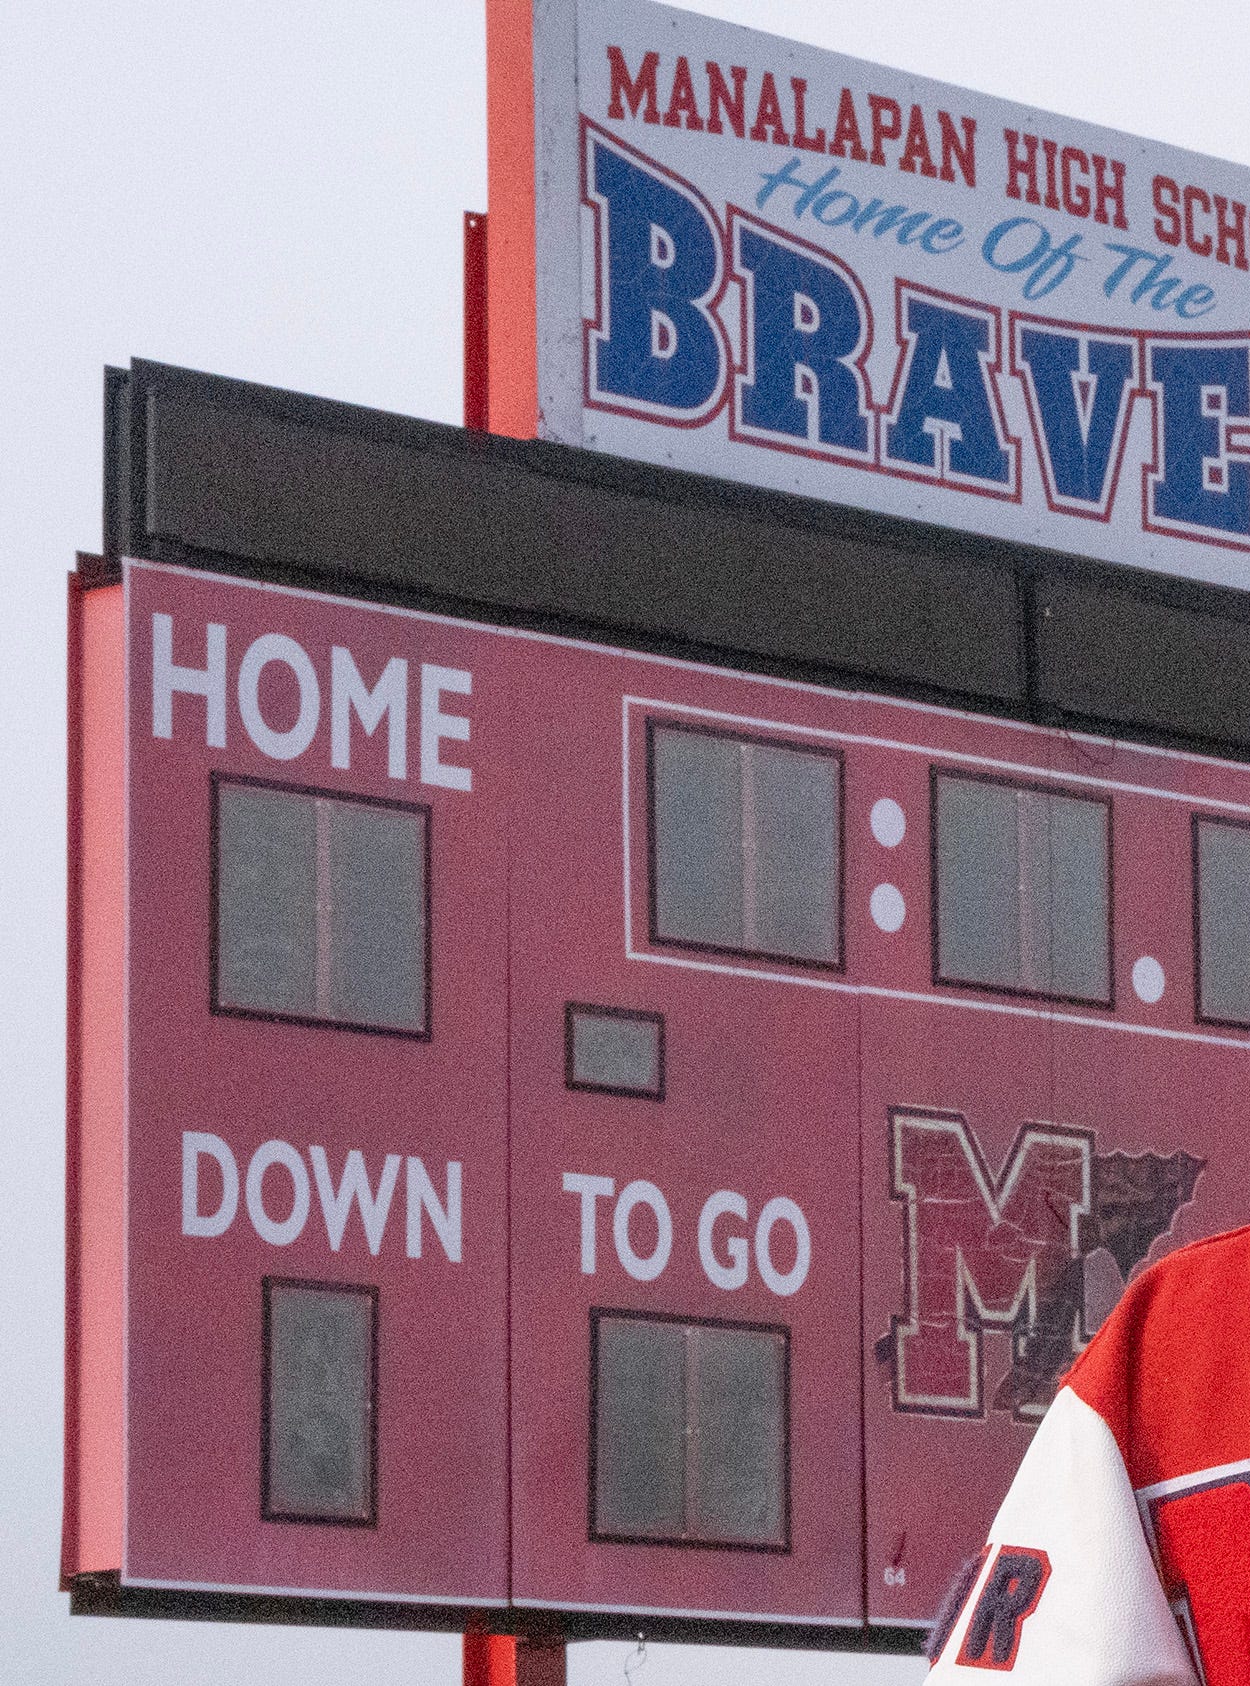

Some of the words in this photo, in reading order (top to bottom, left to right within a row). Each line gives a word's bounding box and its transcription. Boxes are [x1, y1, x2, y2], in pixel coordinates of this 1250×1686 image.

[607, 45, 975, 186] MANALAPAN
[1004, 129, 1128, 229] HIGH
[753, 157, 966, 255] Home
[981, 215, 1088, 301] Of
[1102, 241, 1217, 320] The
[151, 613, 473, 792] HOME
[181, 1131, 463, 1264] DOWN
[562, 1172, 673, 1283] TO
[697, 1190, 812, 1297] GO
[929, 1543, 1053, 1672] R
